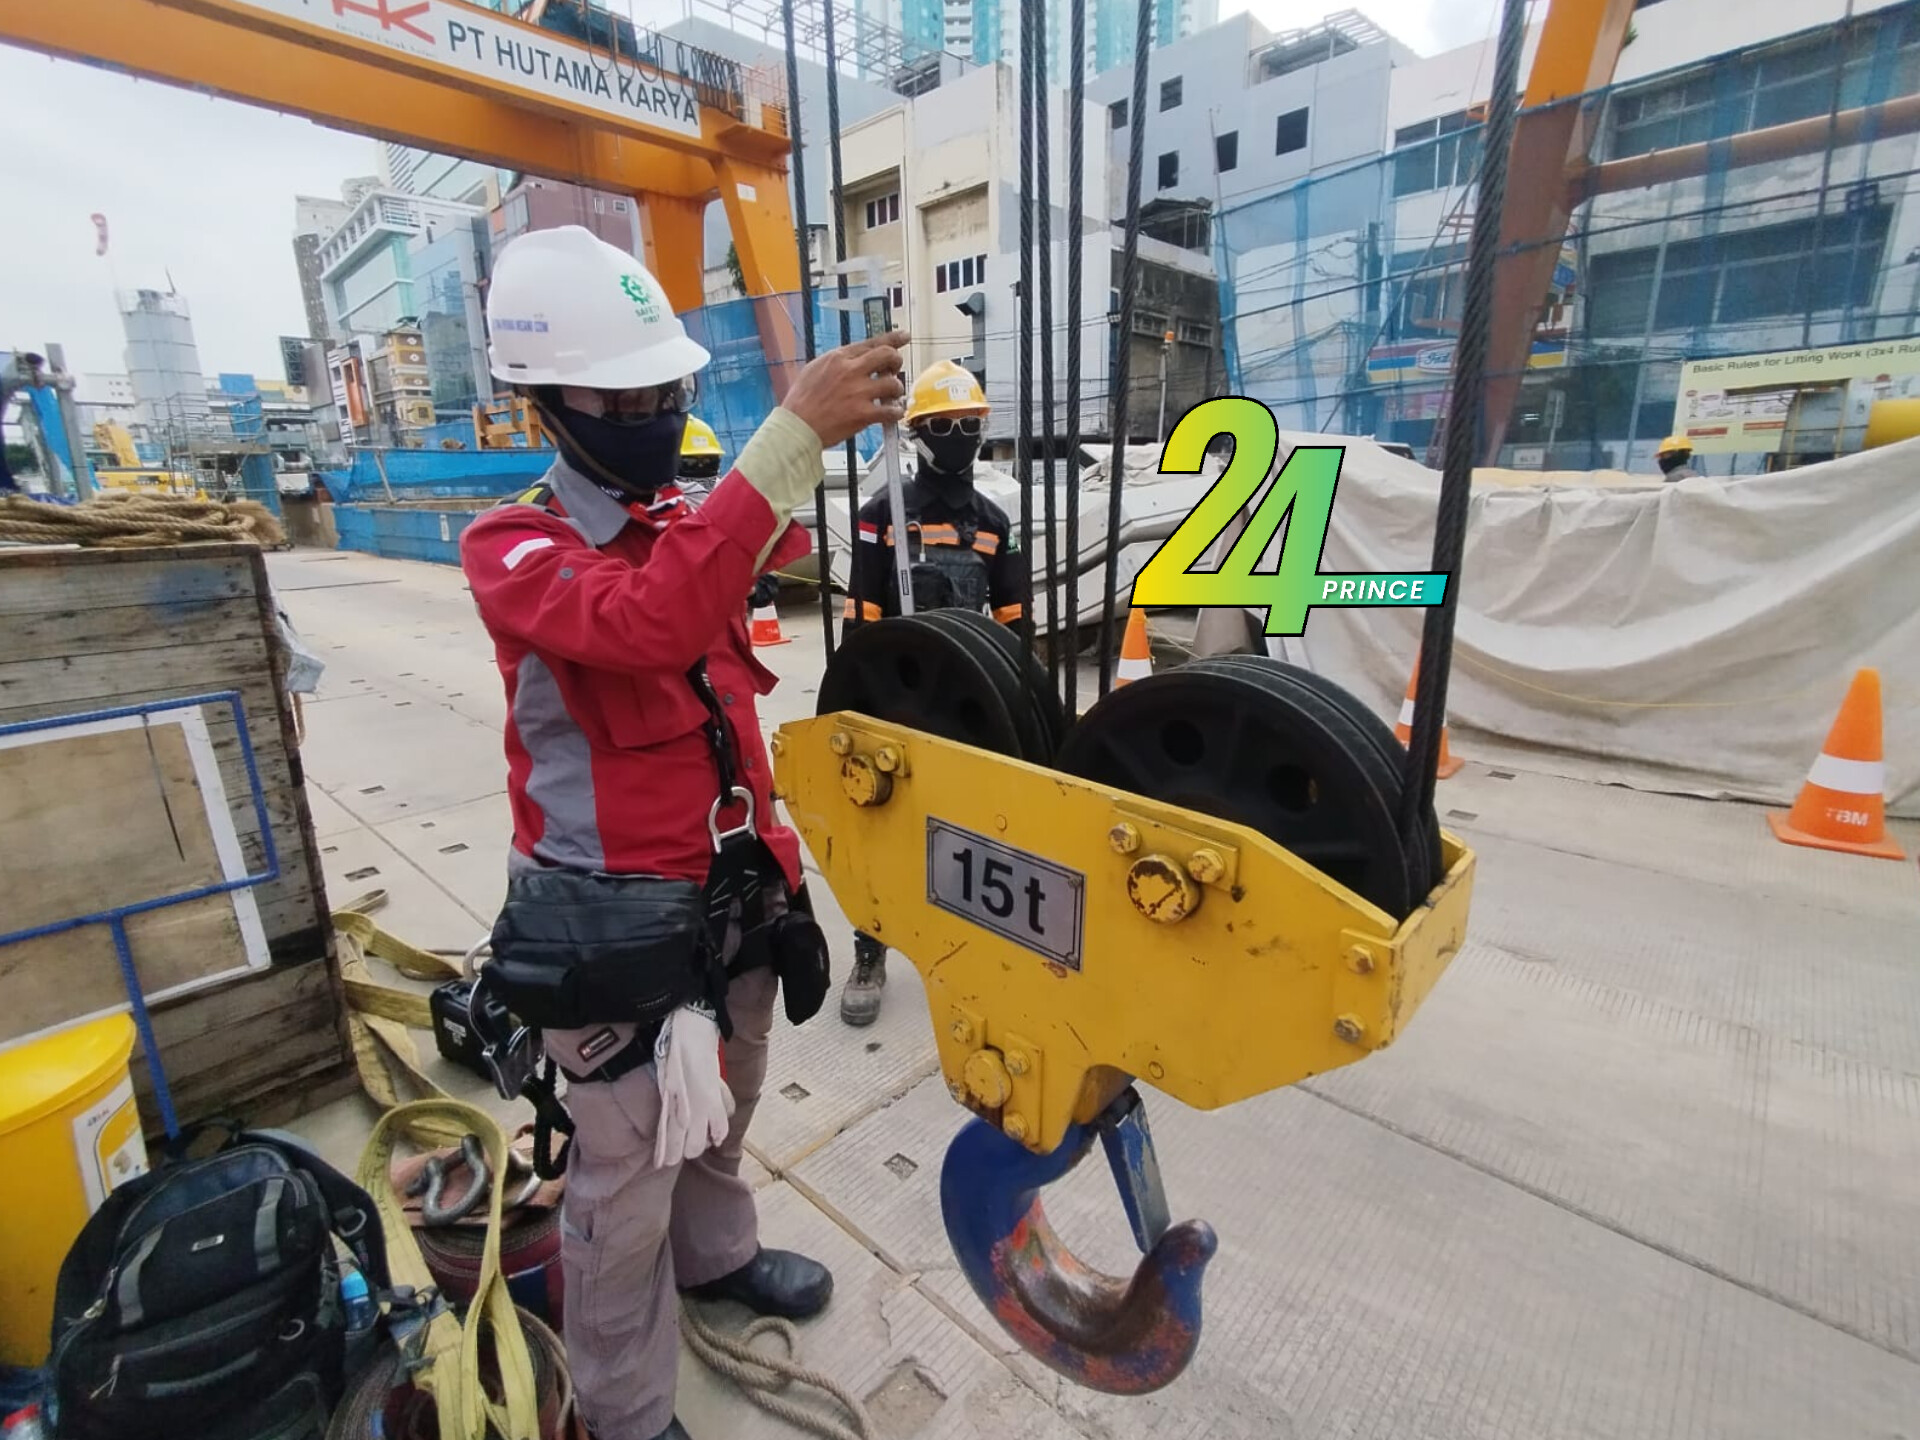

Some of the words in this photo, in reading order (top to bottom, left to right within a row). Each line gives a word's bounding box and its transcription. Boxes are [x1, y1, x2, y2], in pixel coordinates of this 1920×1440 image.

[447, 20, 485, 60] PT
[495, 35, 612, 99] HUTAMA
[618, 75, 698, 126] KARYA
[1693, 363, 1725, 374] Basic
[1728, 360, 1761, 370] Rules
[1764, 358, 1781, 367] for
[1785, 353, 1824, 365] Lifting
[1828, 350, 1861, 361] Work
